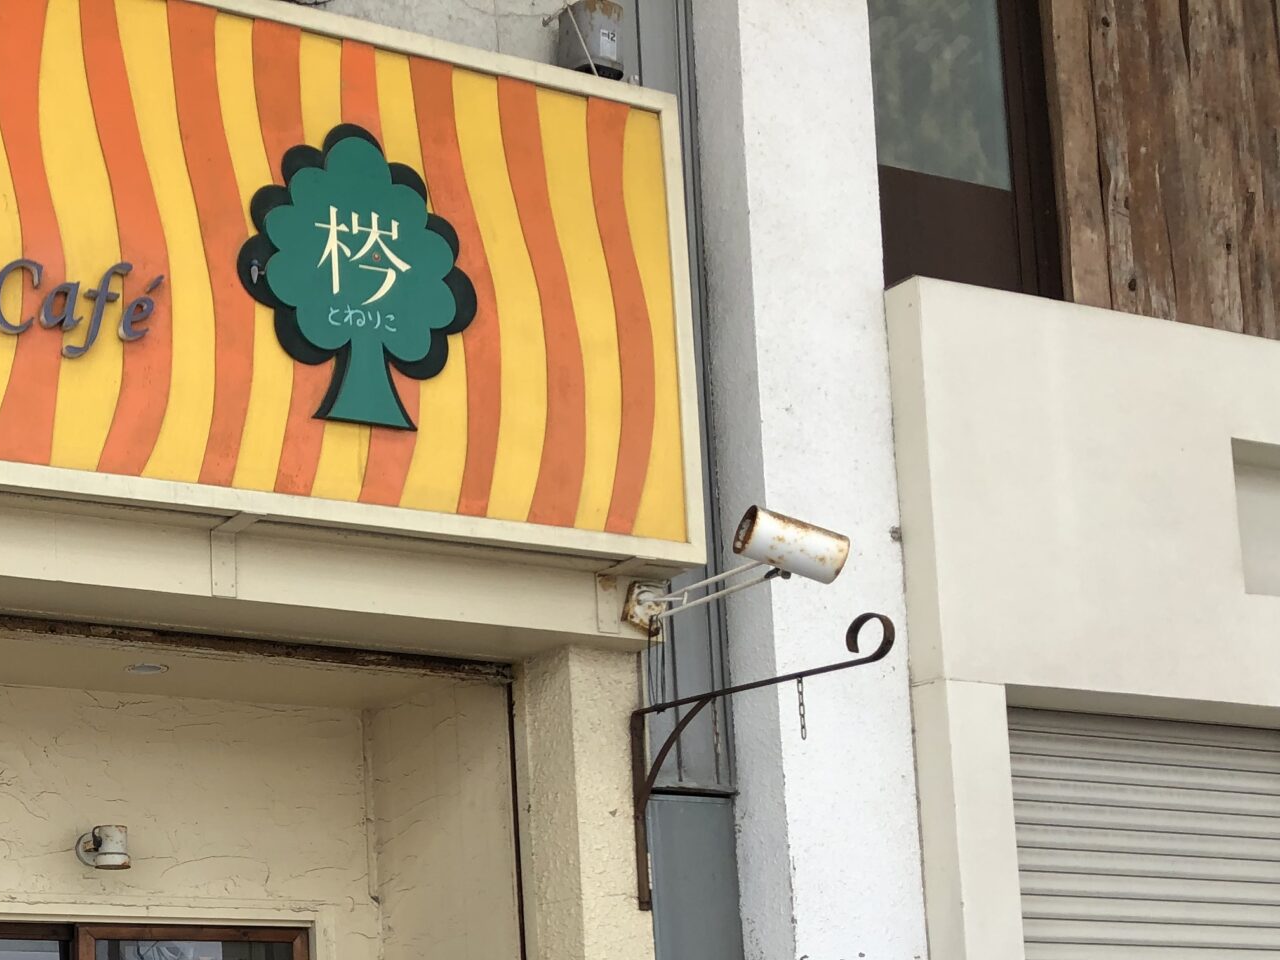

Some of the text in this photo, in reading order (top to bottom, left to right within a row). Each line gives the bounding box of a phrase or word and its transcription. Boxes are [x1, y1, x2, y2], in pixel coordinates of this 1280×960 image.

[314, 205, 412, 306] 梣
[327, 305, 398, 332] とねりこ
